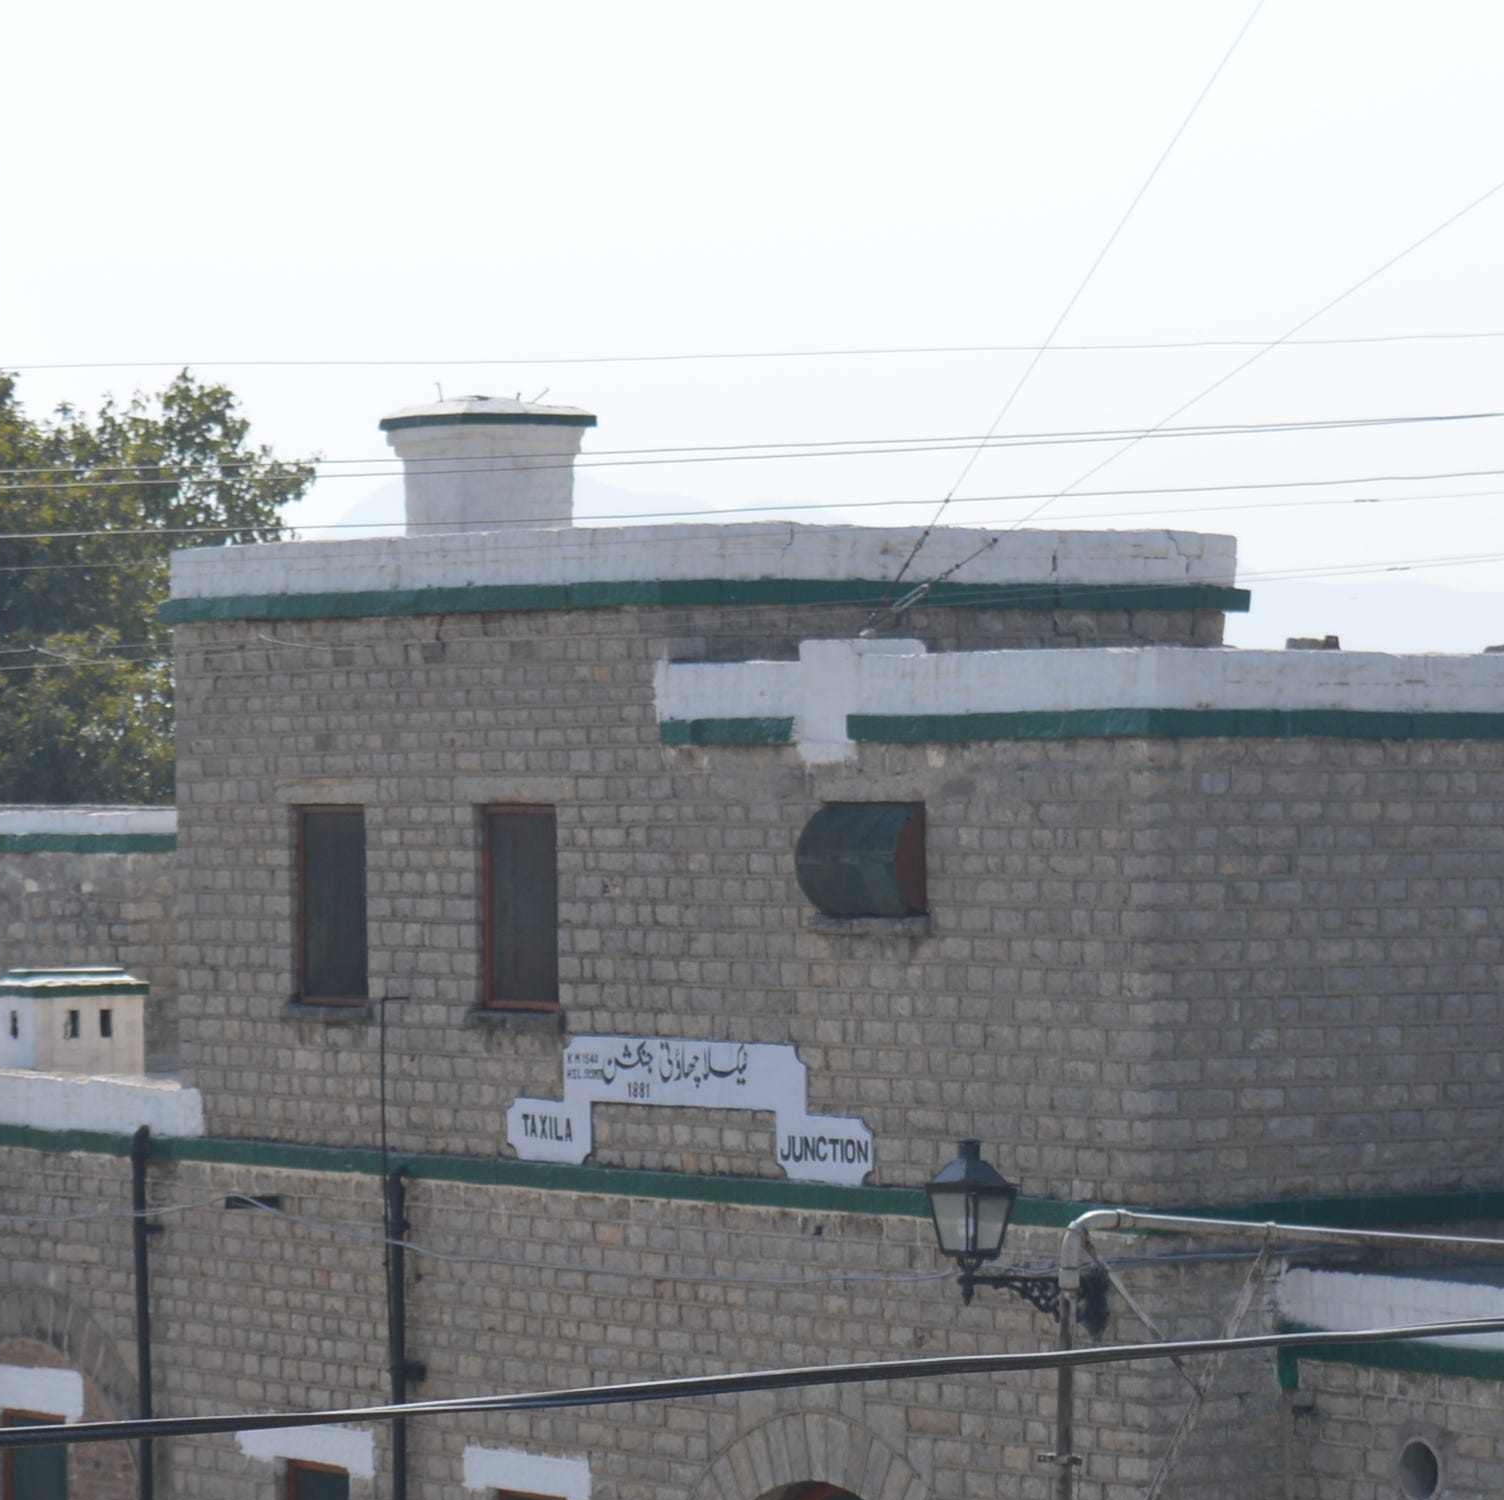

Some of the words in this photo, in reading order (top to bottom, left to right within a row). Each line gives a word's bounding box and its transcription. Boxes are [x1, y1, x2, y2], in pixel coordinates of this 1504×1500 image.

[627, 1081, 651, 1099] 1881
[521, 1113, 573, 1143] TAXILA
[780, 1135, 869, 1165] JUNCTION
